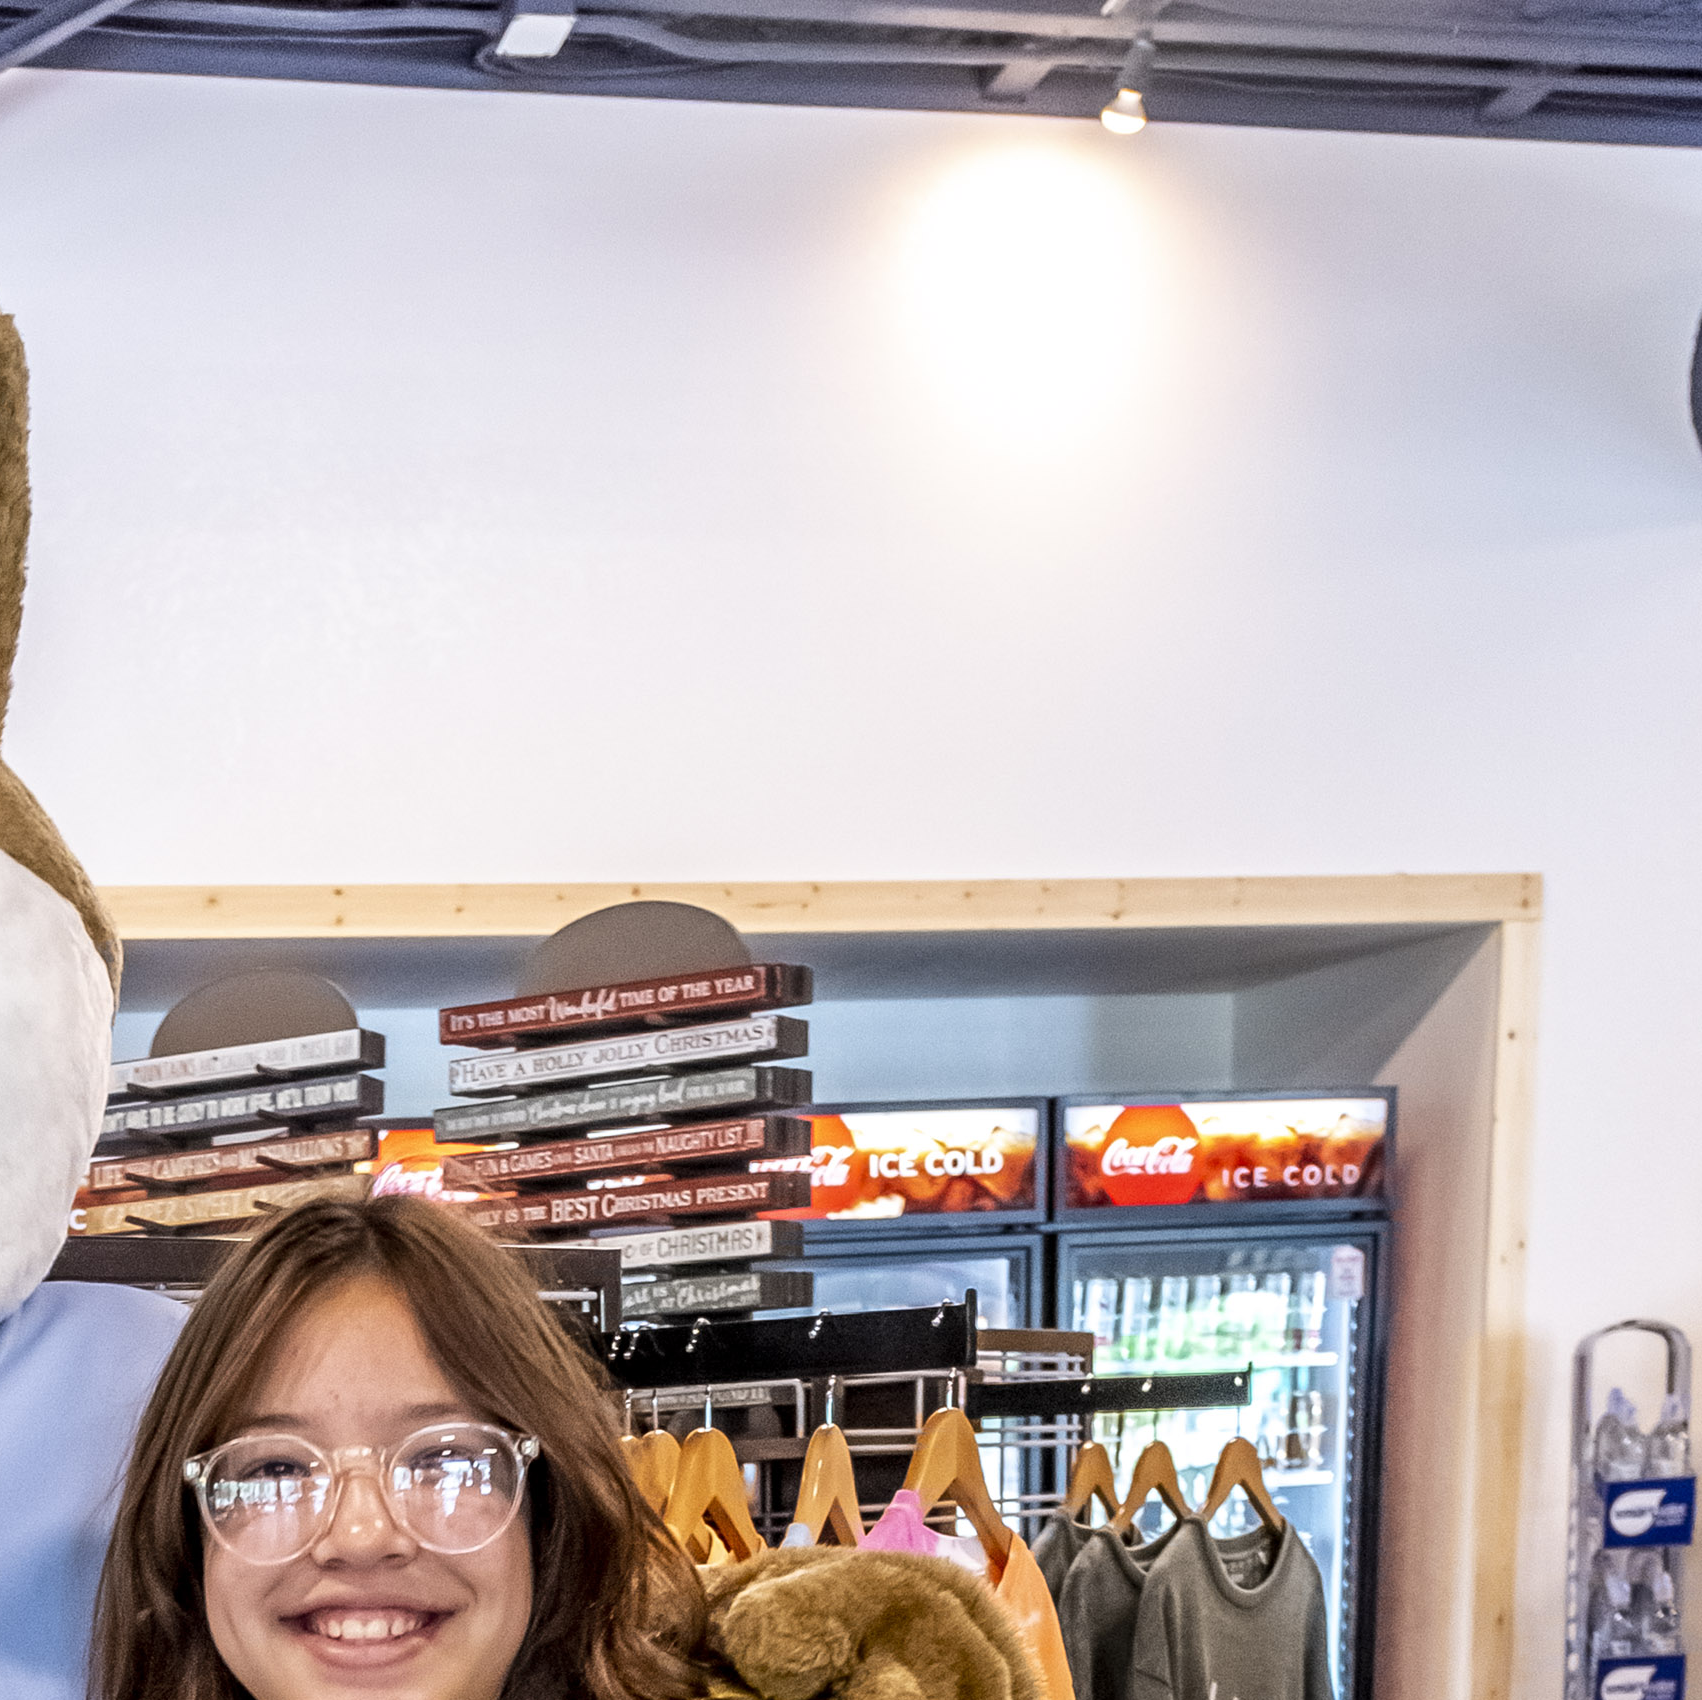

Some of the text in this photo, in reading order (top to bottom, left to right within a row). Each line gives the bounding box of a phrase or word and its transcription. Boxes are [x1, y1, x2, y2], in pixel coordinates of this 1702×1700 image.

[450, 1014, 475, 1032] IT'S
[477, 1011, 505, 1028] THE
[507, 1004, 545, 1024] MOST
[618, 988, 655, 1008] TIME
[657, 985, 678, 1003] OF
[679, 981, 711, 999] THE
[713, 974, 755, 995] YEAR
[462, 1024, 763, 1083] HAVE A HOLLY JOLLY CHRISTMAS
[510, 1151, 553, 1172] GAMES
[574, 1144, 613, 1164] SANTA
[655, 1131, 715, 1155] NAUGHTY
[716, 1126, 744, 1147] LIST
[869, 1151, 918, 1178] ICE
[924, 1151, 1004, 1176] COLD
[1101, 1136, 1200, 1176] Coca-Cola
[1221, 1163, 1361, 1188] ICE COLD
[505, 1209, 519, 1223] IS
[522, 1206, 548, 1221] THE
[550, 1195, 599, 1223] BEST
[601, 1190, 692, 1218] CHRISTMAS
[695, 1182, 770, 1205] PRESENT
[657, 1228, 753, 1259] CHRISTMAS
